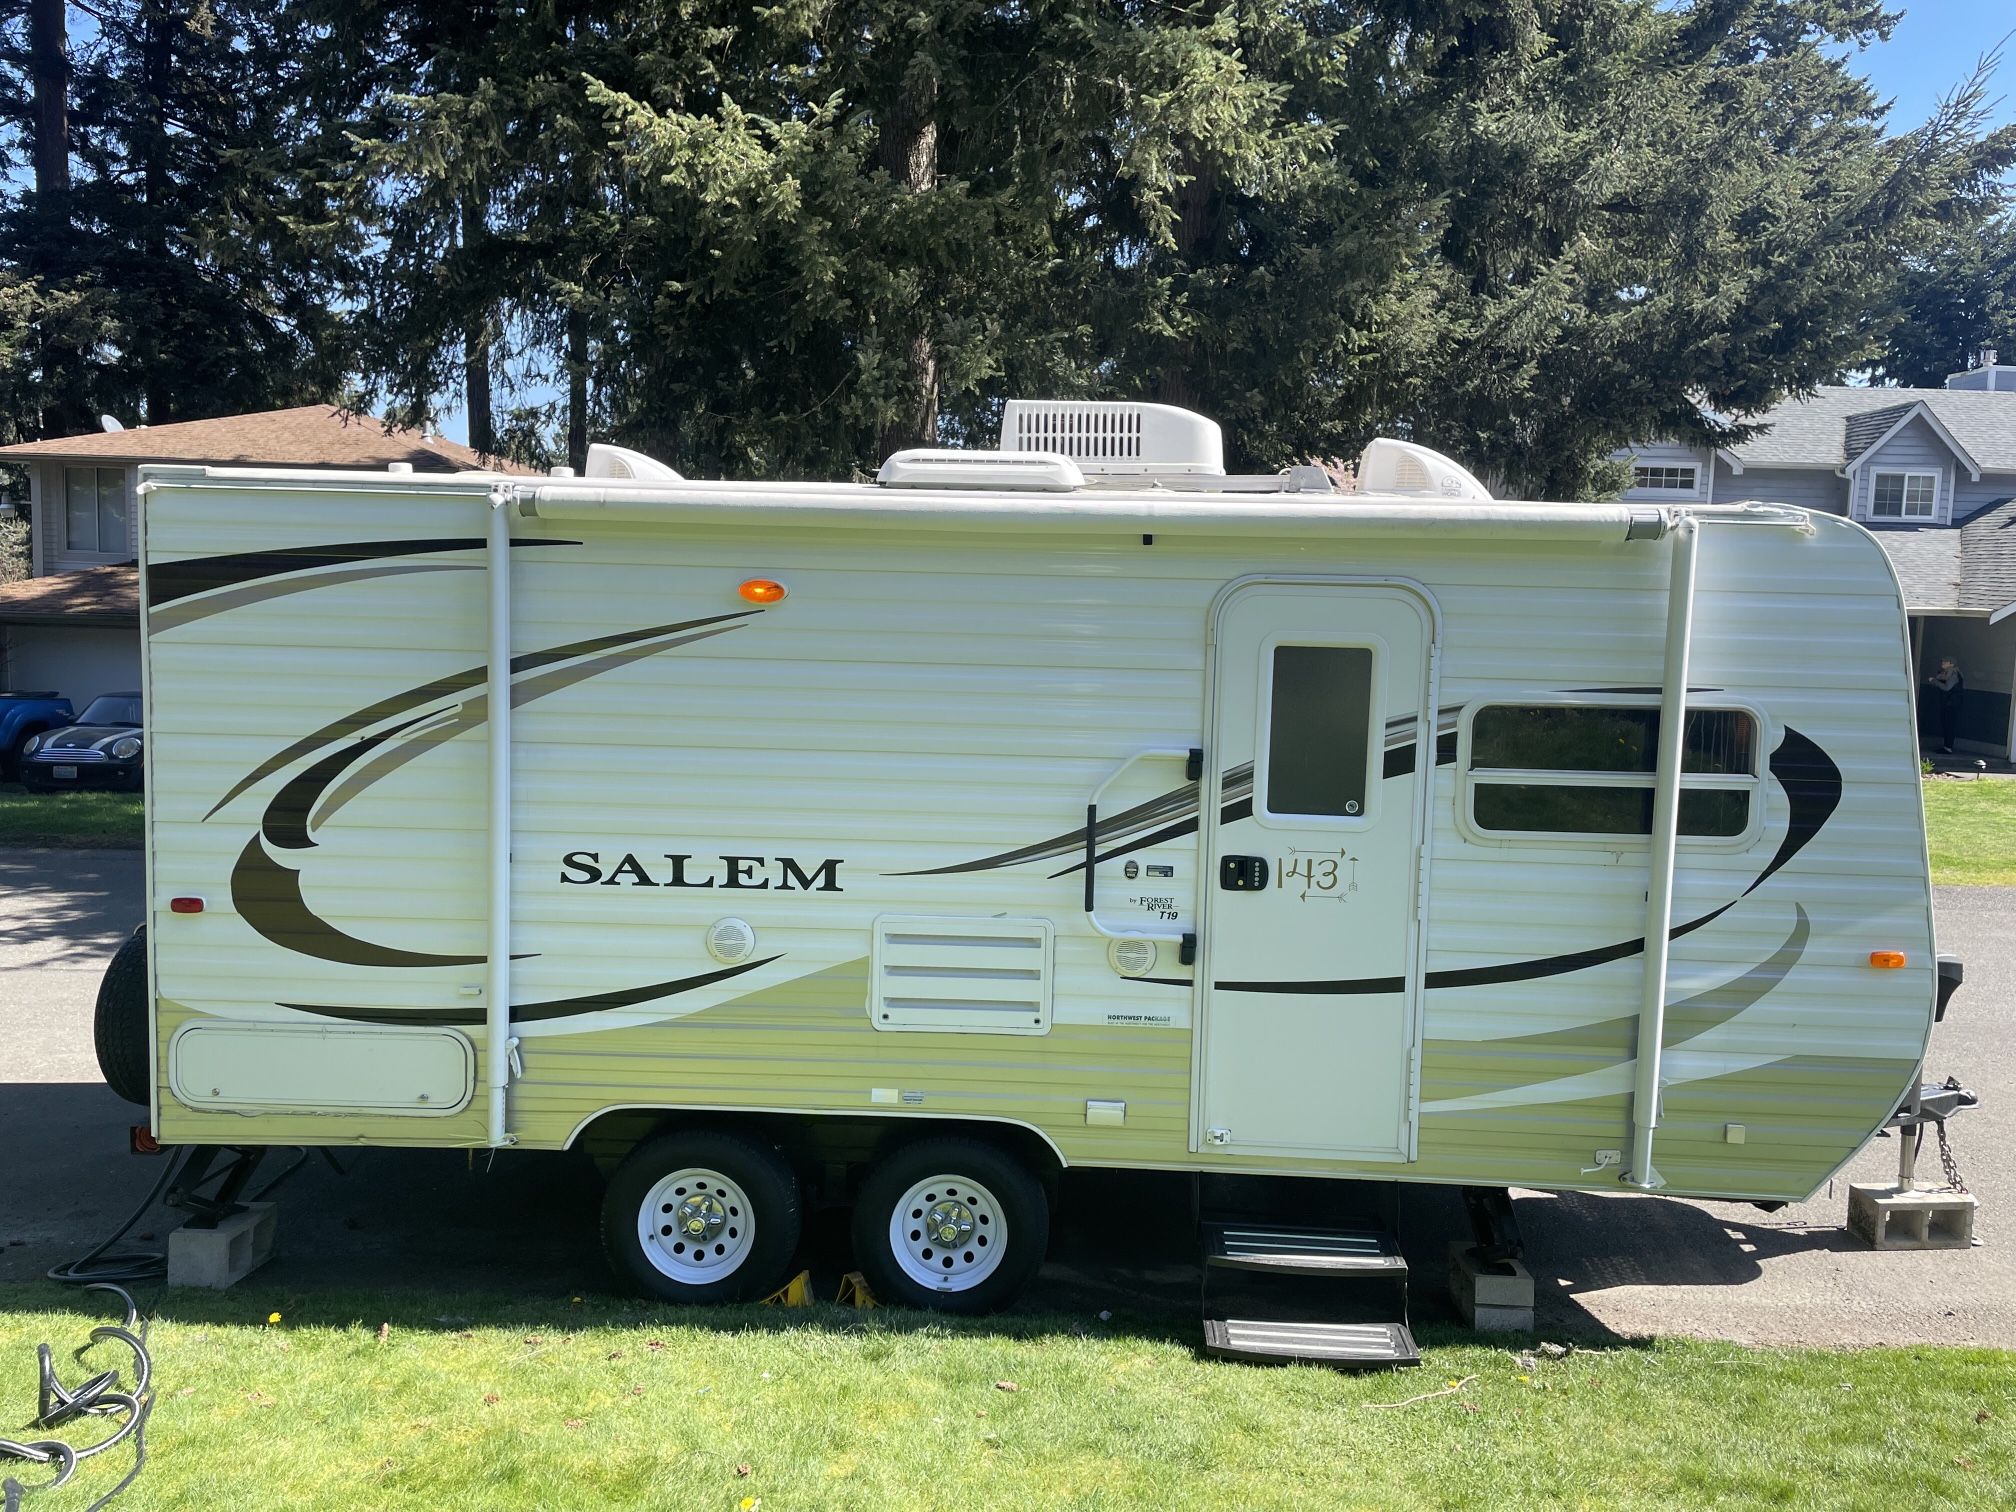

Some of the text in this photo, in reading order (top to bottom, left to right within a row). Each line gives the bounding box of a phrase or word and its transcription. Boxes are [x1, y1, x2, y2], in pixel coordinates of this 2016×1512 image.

[560, 851, 845, 892] SALEM
[1277, 857, 1339, 890] 143
[1139, 896, 1175, 906] FOREST
[1147, 902, 1173, 911] RIVER
[1159, 911, 1178, 920] T19
